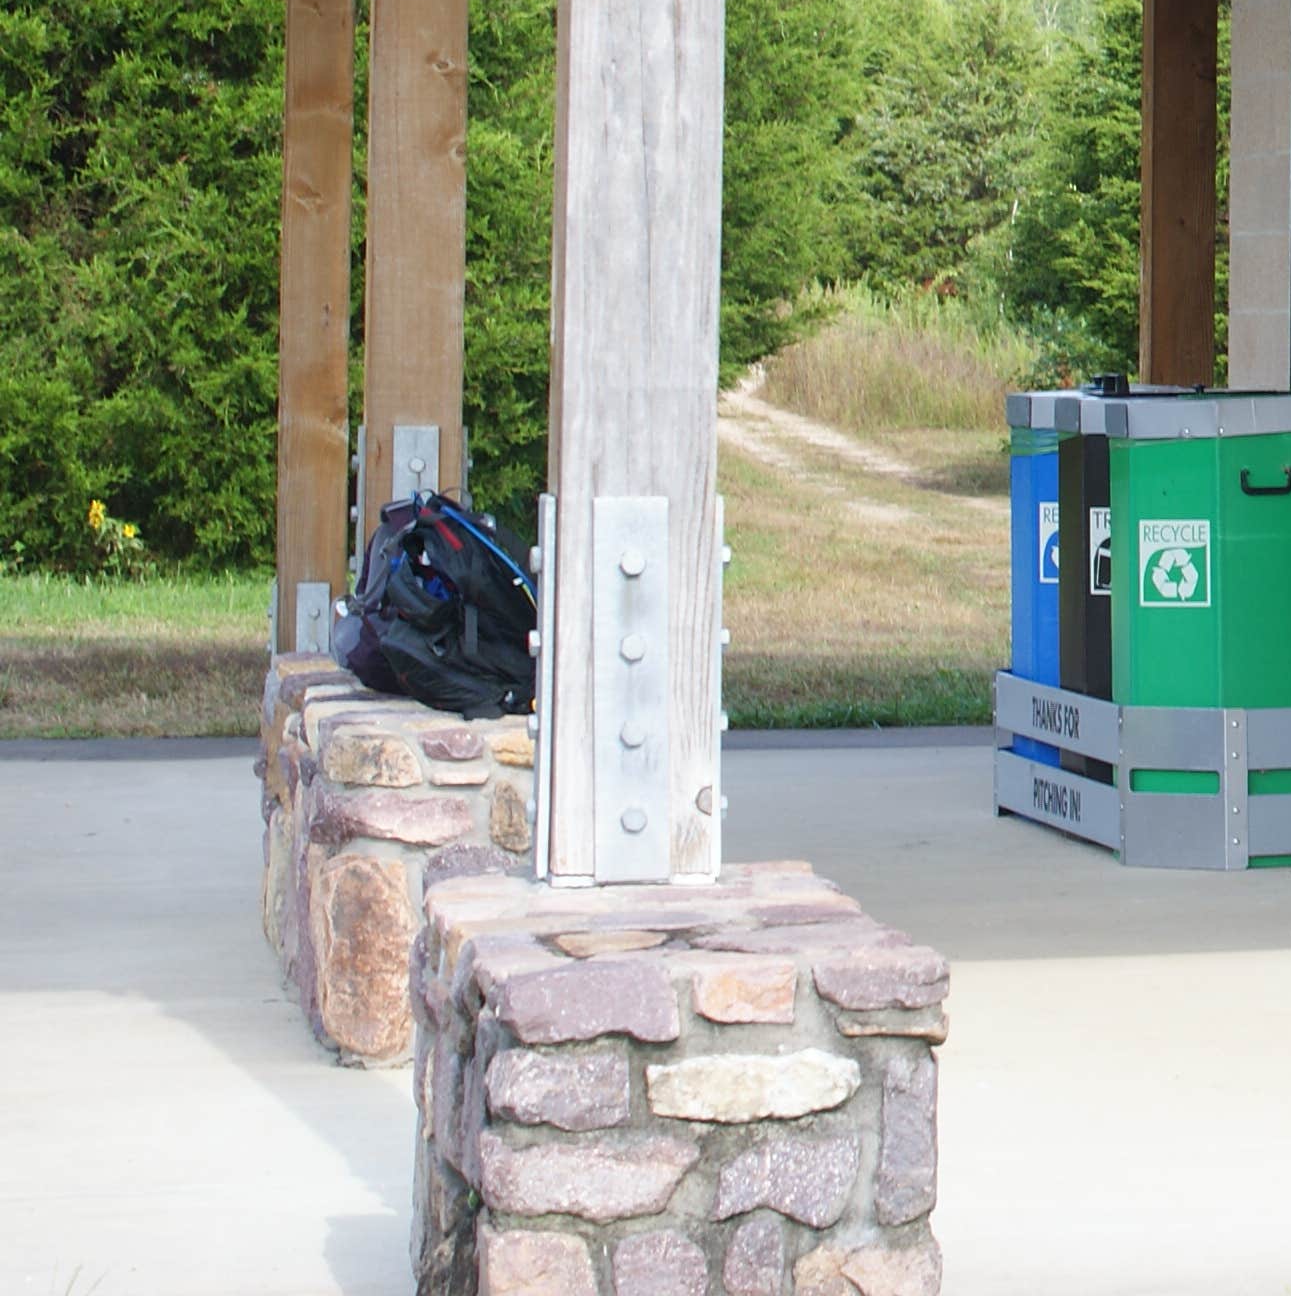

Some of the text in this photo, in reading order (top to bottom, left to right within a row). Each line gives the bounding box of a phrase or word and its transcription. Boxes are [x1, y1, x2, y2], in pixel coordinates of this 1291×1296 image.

[1142, 524, 1206, 543] RECYCLE
[1032, 695, 1080, 740] THANKS FOR
[1033, 776, 1081, 822] PITCHING IN!
